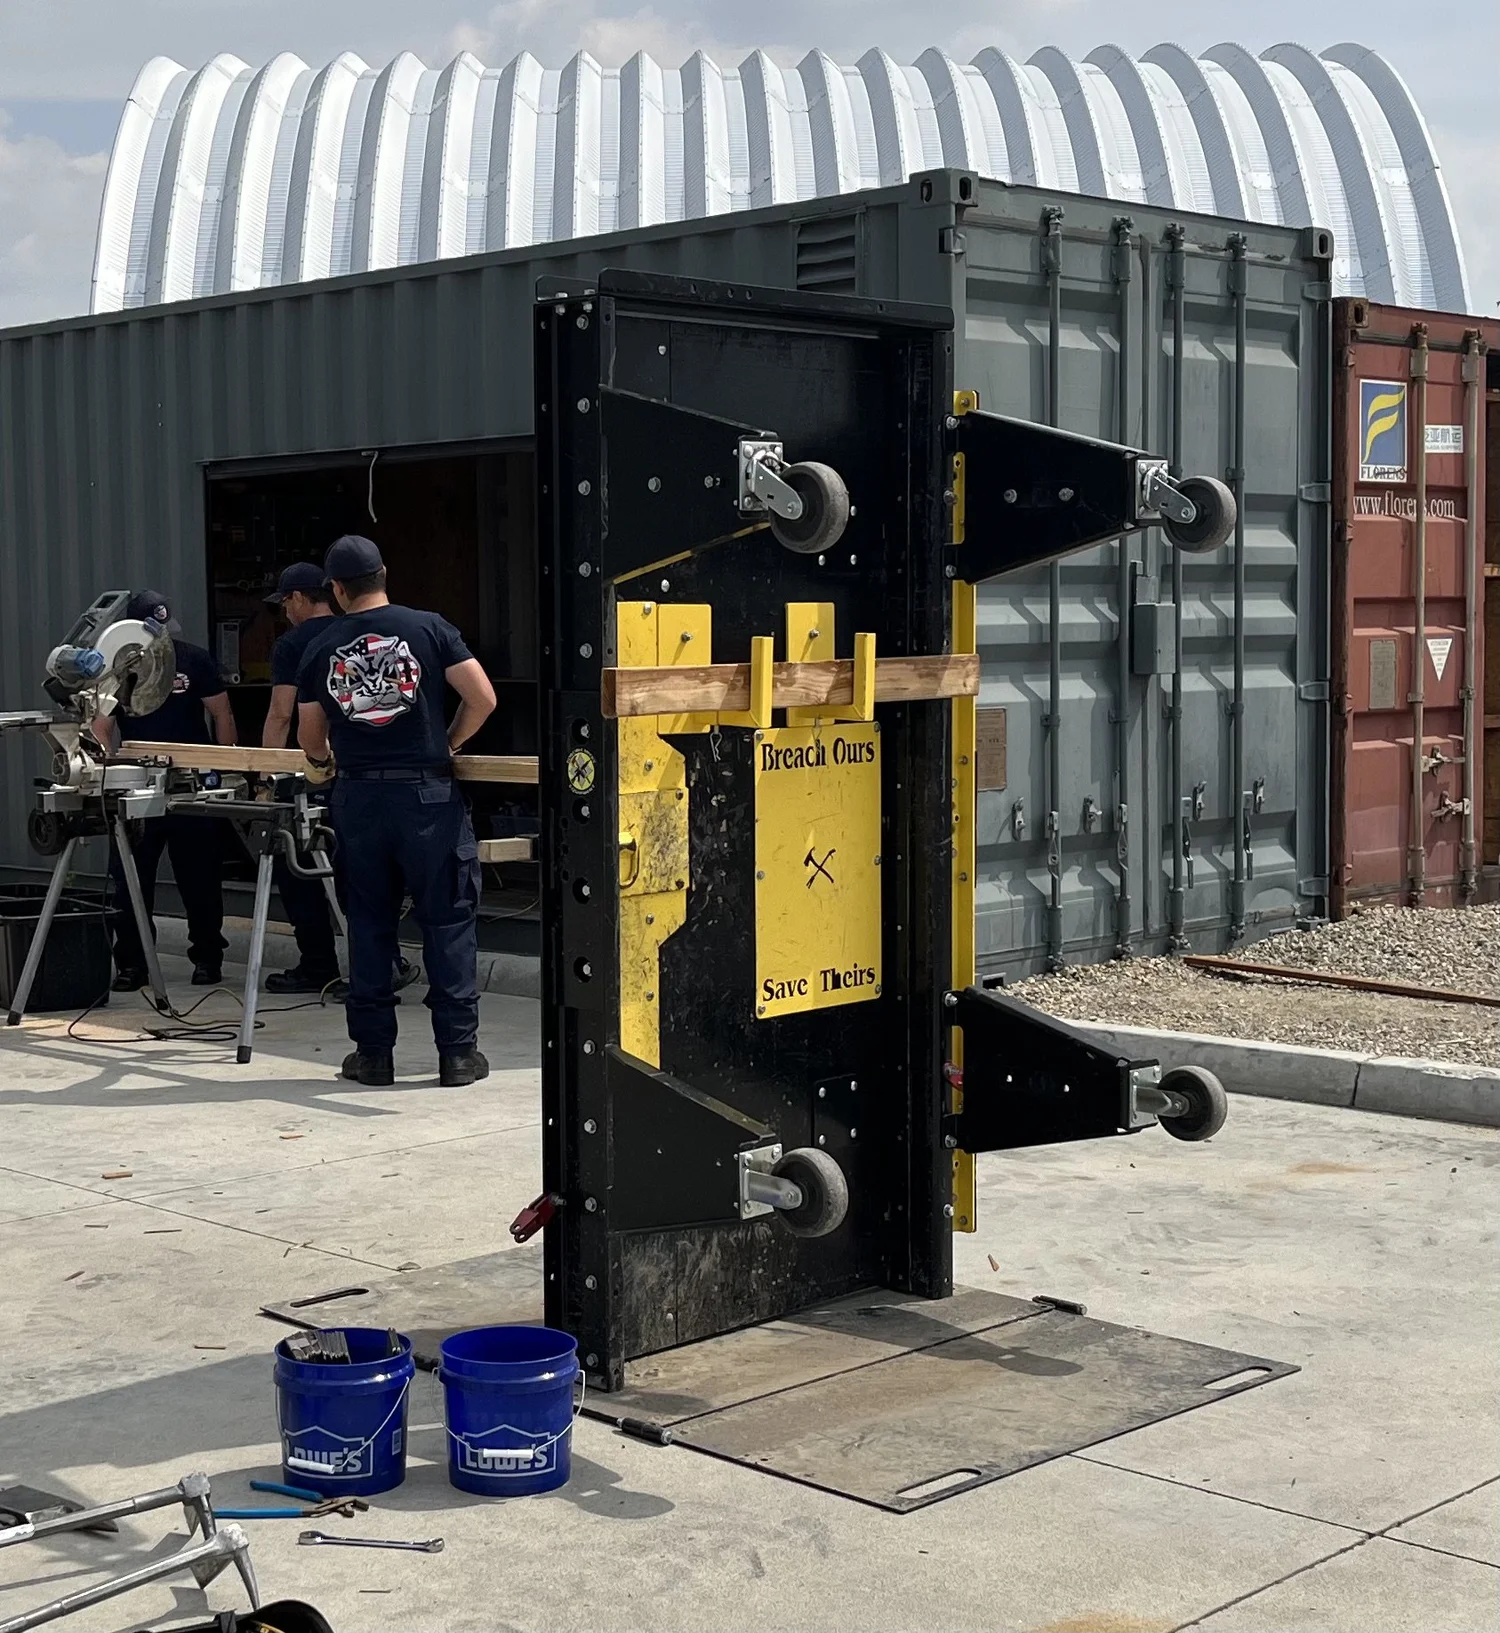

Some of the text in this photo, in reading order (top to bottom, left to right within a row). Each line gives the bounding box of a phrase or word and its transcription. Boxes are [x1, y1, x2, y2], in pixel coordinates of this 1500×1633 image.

[1360, 466, 1405, 480] FLORENS
[761, 737, 875, 772] Breach Ours
[762, 963, 876, 1002] Save Theirs
